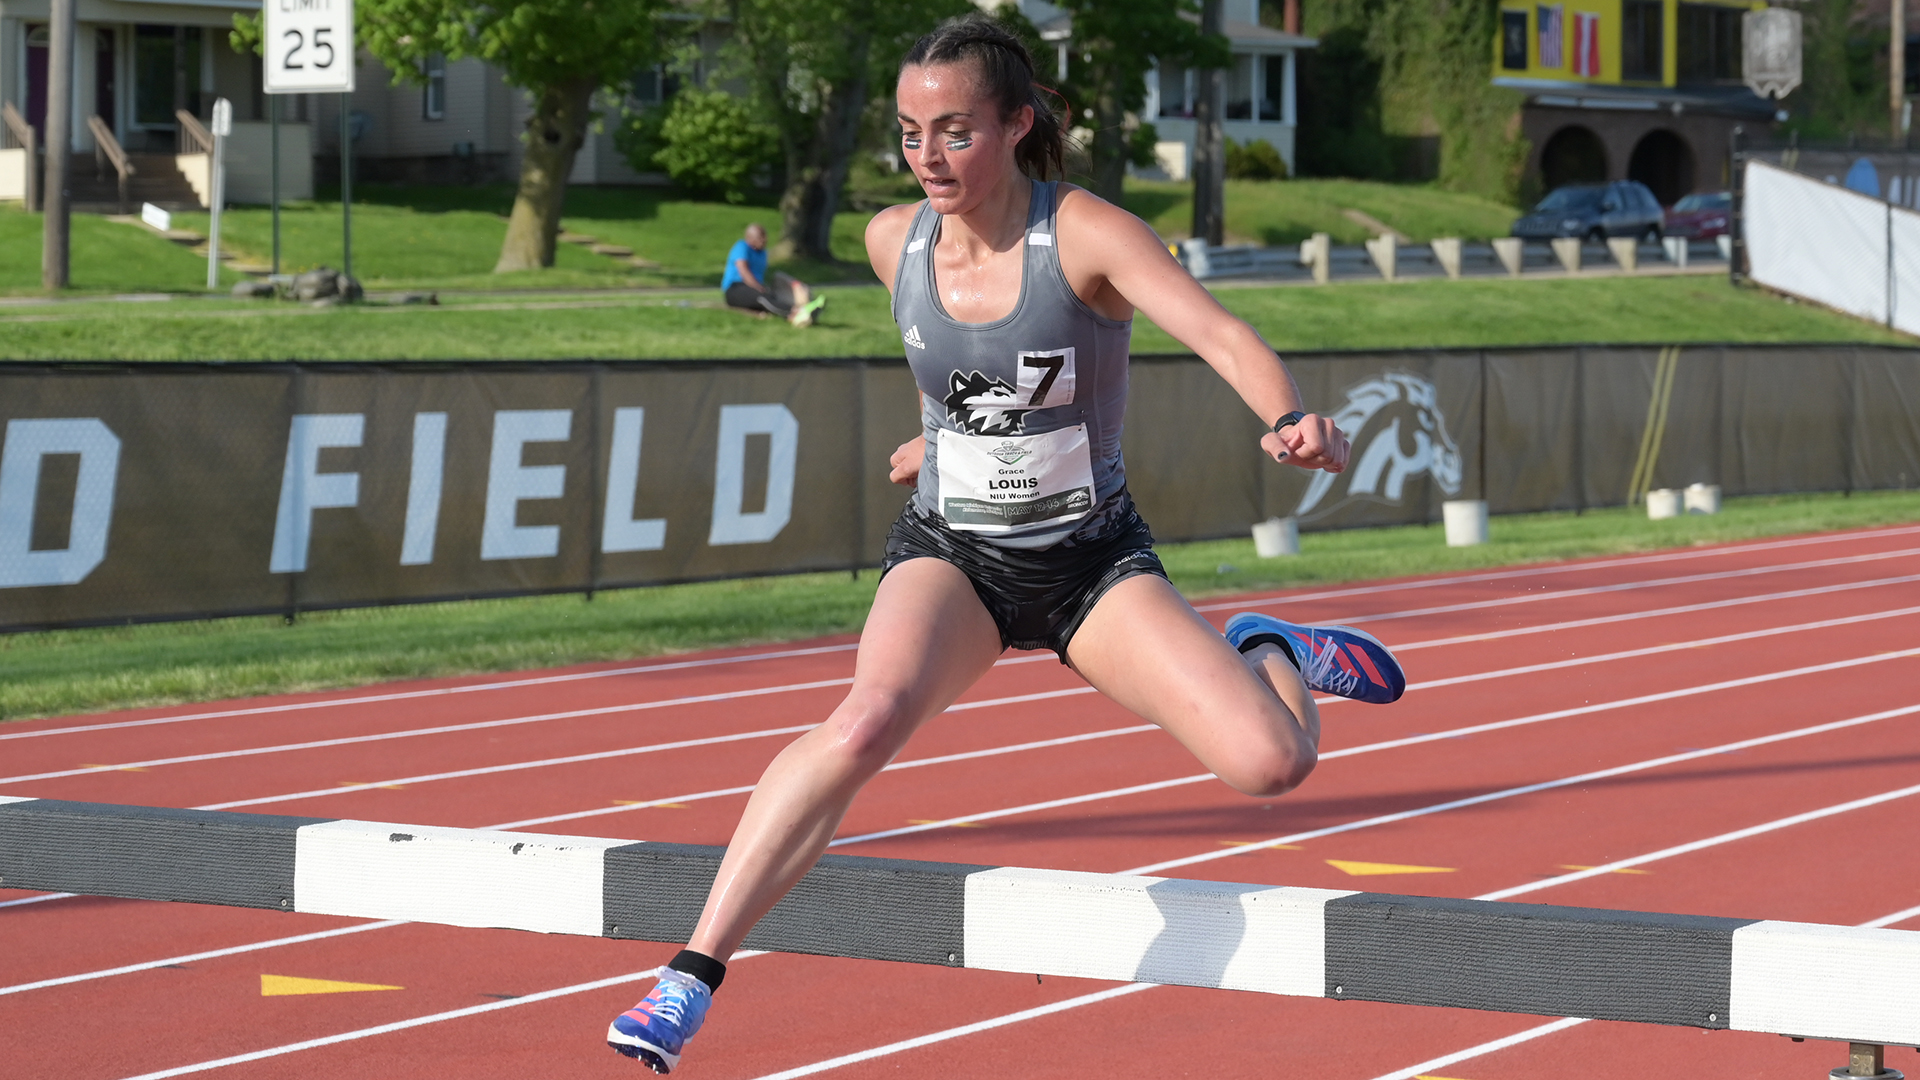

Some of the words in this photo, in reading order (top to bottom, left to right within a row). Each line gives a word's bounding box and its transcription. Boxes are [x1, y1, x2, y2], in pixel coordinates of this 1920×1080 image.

[281, 0, 330, 12] LIMIT
[283, 28, 334, 69] 25
[1023, 355, 1065, 406] 7
[270, 404, 799, 573] FIELD
[989, 477, 1038, 490] LOUIS
[1008, 490, 1040, 500] Women
[1008, 503, 1033, 517] MAY
[1114, 551, 1149, 567] adidas
